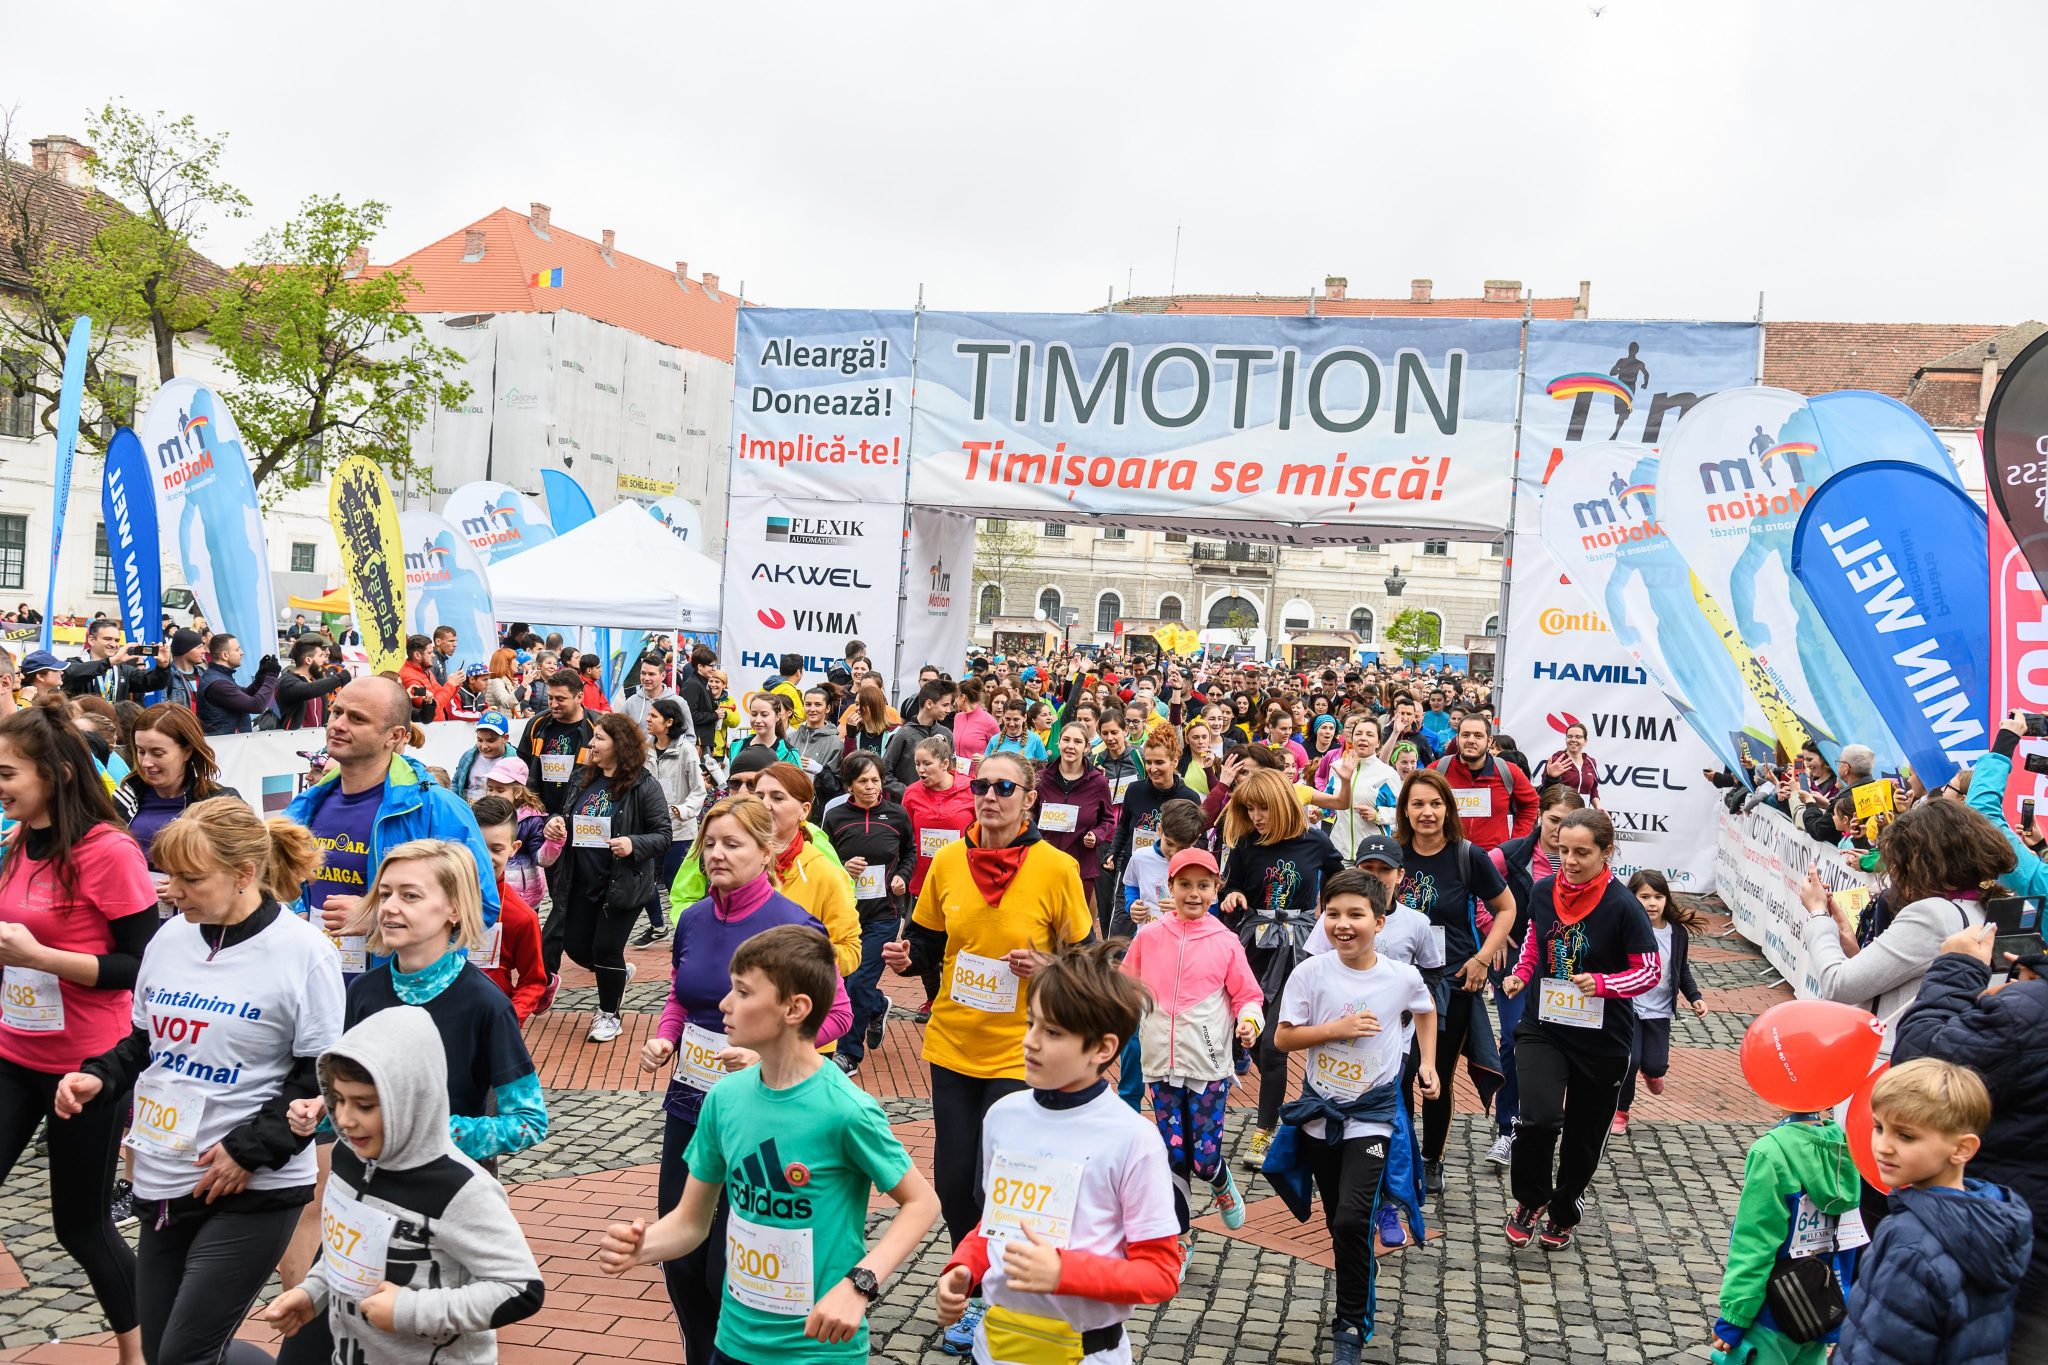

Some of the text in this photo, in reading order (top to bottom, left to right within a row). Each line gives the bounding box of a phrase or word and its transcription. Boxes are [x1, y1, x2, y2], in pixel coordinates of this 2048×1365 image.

[761, 338, 888, 376] Aleargă!
[751, 385, 892, 418] Donează!
[957, 343, 1463, 435] TIMOTION
[739, 432, 900, 469] Implică-te!
[962, 441, 1451, 513] Timișoara se mișcă!
[791, 518, 864, 537] FLEXIK
[791, 536, 838, 545] AUTOMATION
[752, 563, 872, 589] AKWEL
[1534, 661, 1647, 685] HAMILT
[576, 824, 602, 835] 8665
[1043, 811, 1067, 821] 8092
[1607, 810, 1669, 832] EXIK
[1667, 868, 1690, 881] V-a
[956, 966, 997, 992] 8844
[155, 988, 236, 1015] întâlnim
[239, 1002, 262, 1021] la
[1545, 989, 1585, 1010] 7311
[152, 1014, 209, 1044] VOT
[161, 1051, 187, 1073] 26
[186, 1062, 242, 1085] mai
[1317, 1052, 1362, 1080] 8723
[138, 1096, 177, 1131] 7730
[731, 1183, 813, 1219] adidas
[992, 1177, 1052, 1212] 8797
[729, 1235, 780, 1280] 7300
